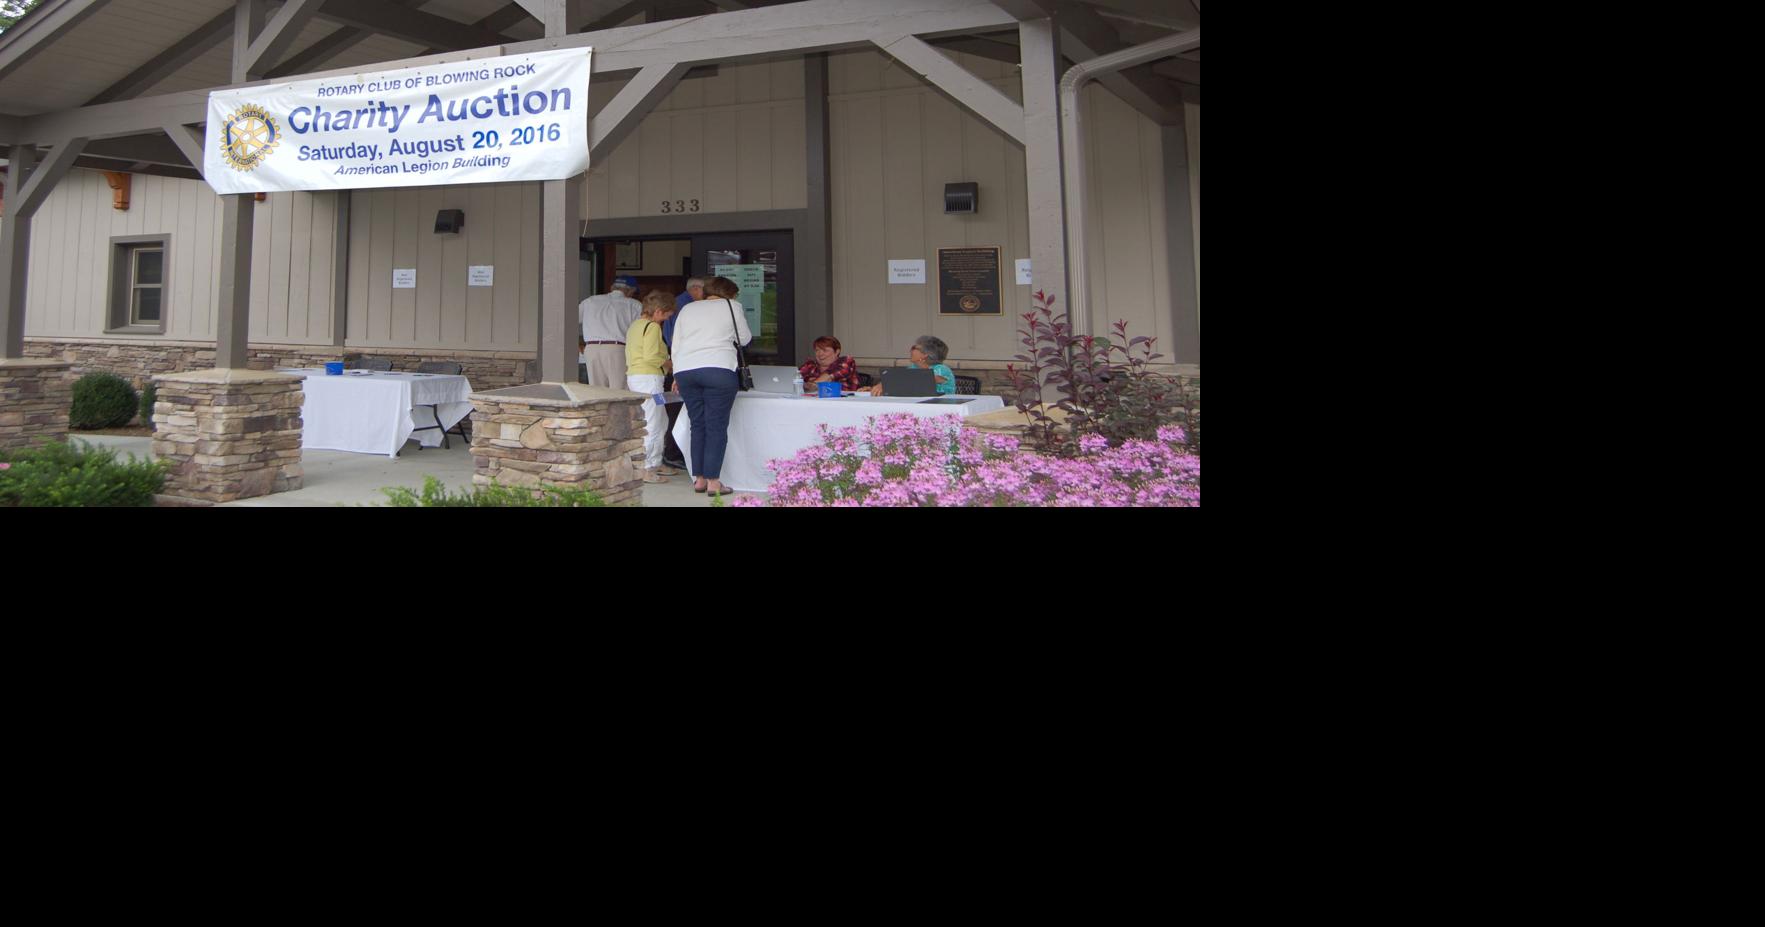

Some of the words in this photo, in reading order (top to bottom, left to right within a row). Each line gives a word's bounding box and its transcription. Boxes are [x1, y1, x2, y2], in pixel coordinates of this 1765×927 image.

[317, 84, 365, 97] ROTARY
[368, 80, 401, 92] CLUB
[405, 77, 422, 89] OF
[426, 69, 489, 86] BLOWING
[494, 64, 536, 79] ROCK
[288, 100, 411, 134] Charity
[417, 85, 572, 123] Auction
[297, 142, 383, 161] Saturday,
[389, 134, 465, 158] August
[472, 130, 503, 150] 20,
[509, 123, 561, 146] 2016
[334, 164, 398, 175] American
[402, 160, 449, 174] Legion
[452, 155, 511, 168] Building
